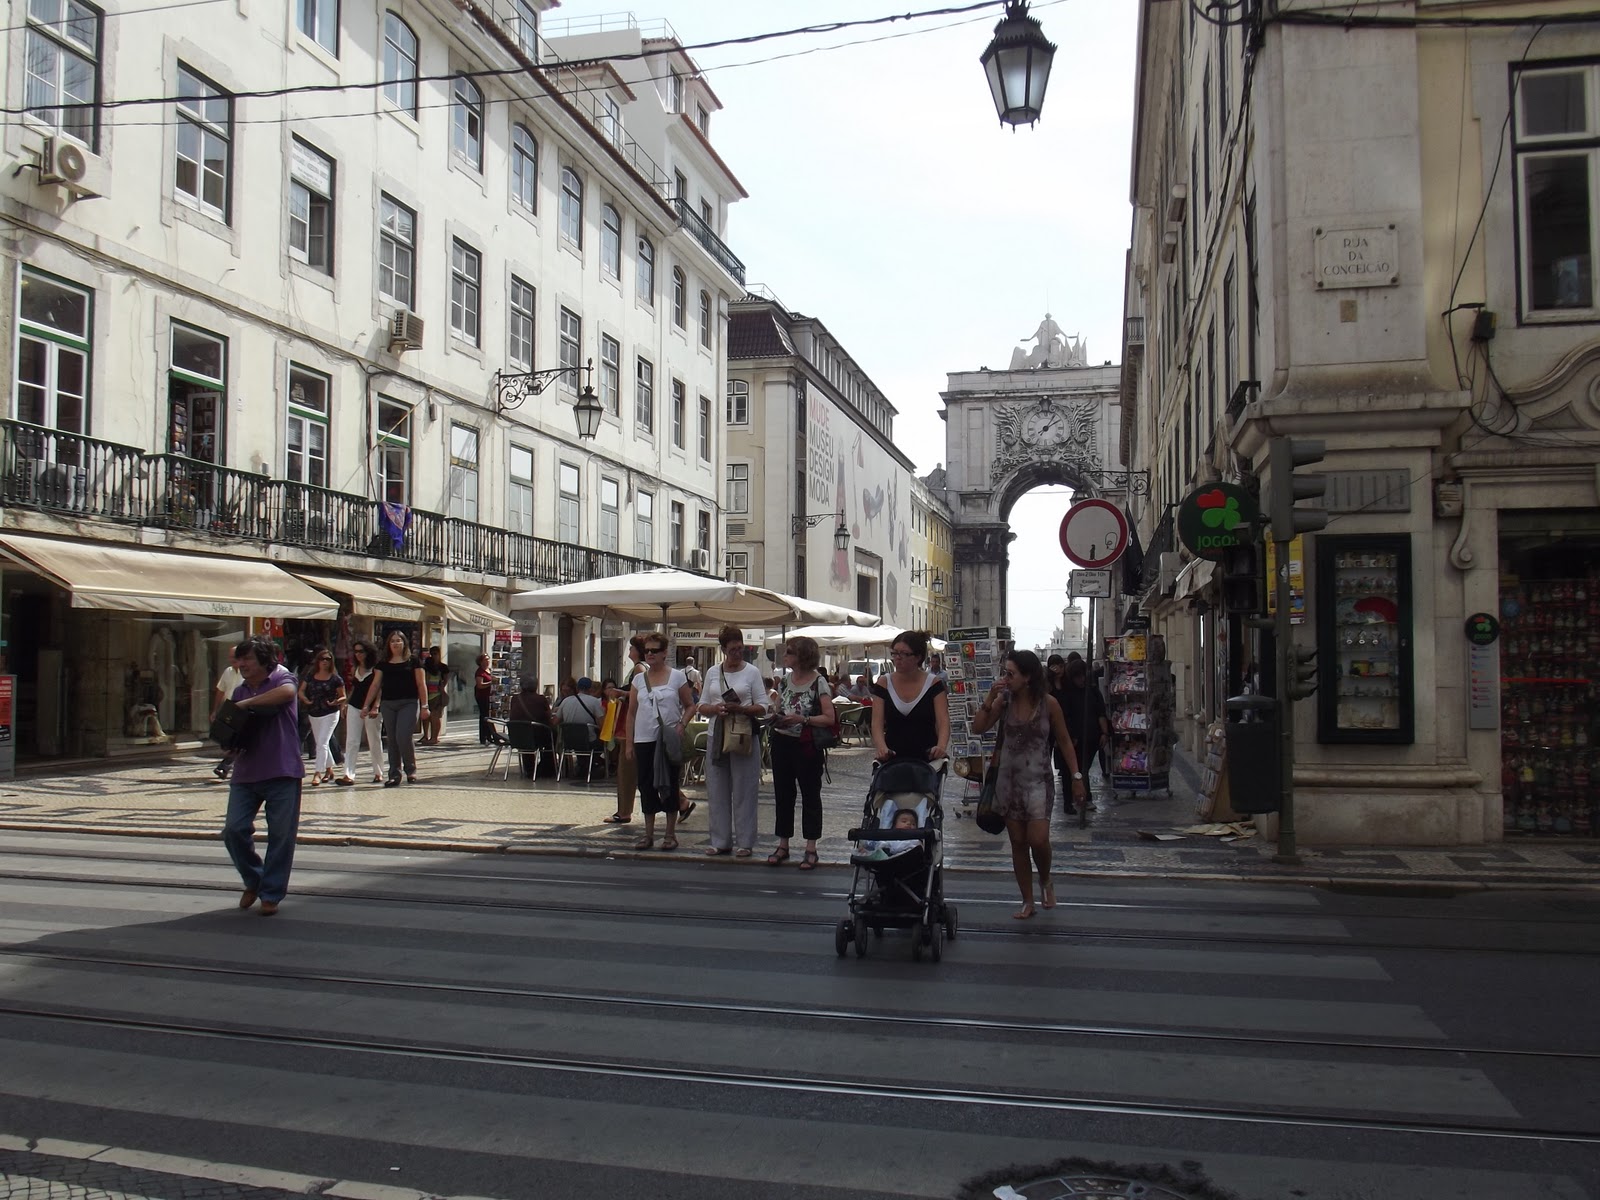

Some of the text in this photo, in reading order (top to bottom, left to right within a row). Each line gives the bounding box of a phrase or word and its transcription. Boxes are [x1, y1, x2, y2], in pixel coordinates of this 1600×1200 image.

[1343, 238, 1369, 248] RUA
[1348, 251, 1363, 261] DA
[809, 393, 830, 432] MUDE
[809, 420, 834, 459] MUSEU
[809, 446, 835, 485] DESIGN
[809, 473, 830, 507] MODA
[673, 631, 702, 639] RESTAURANTE
